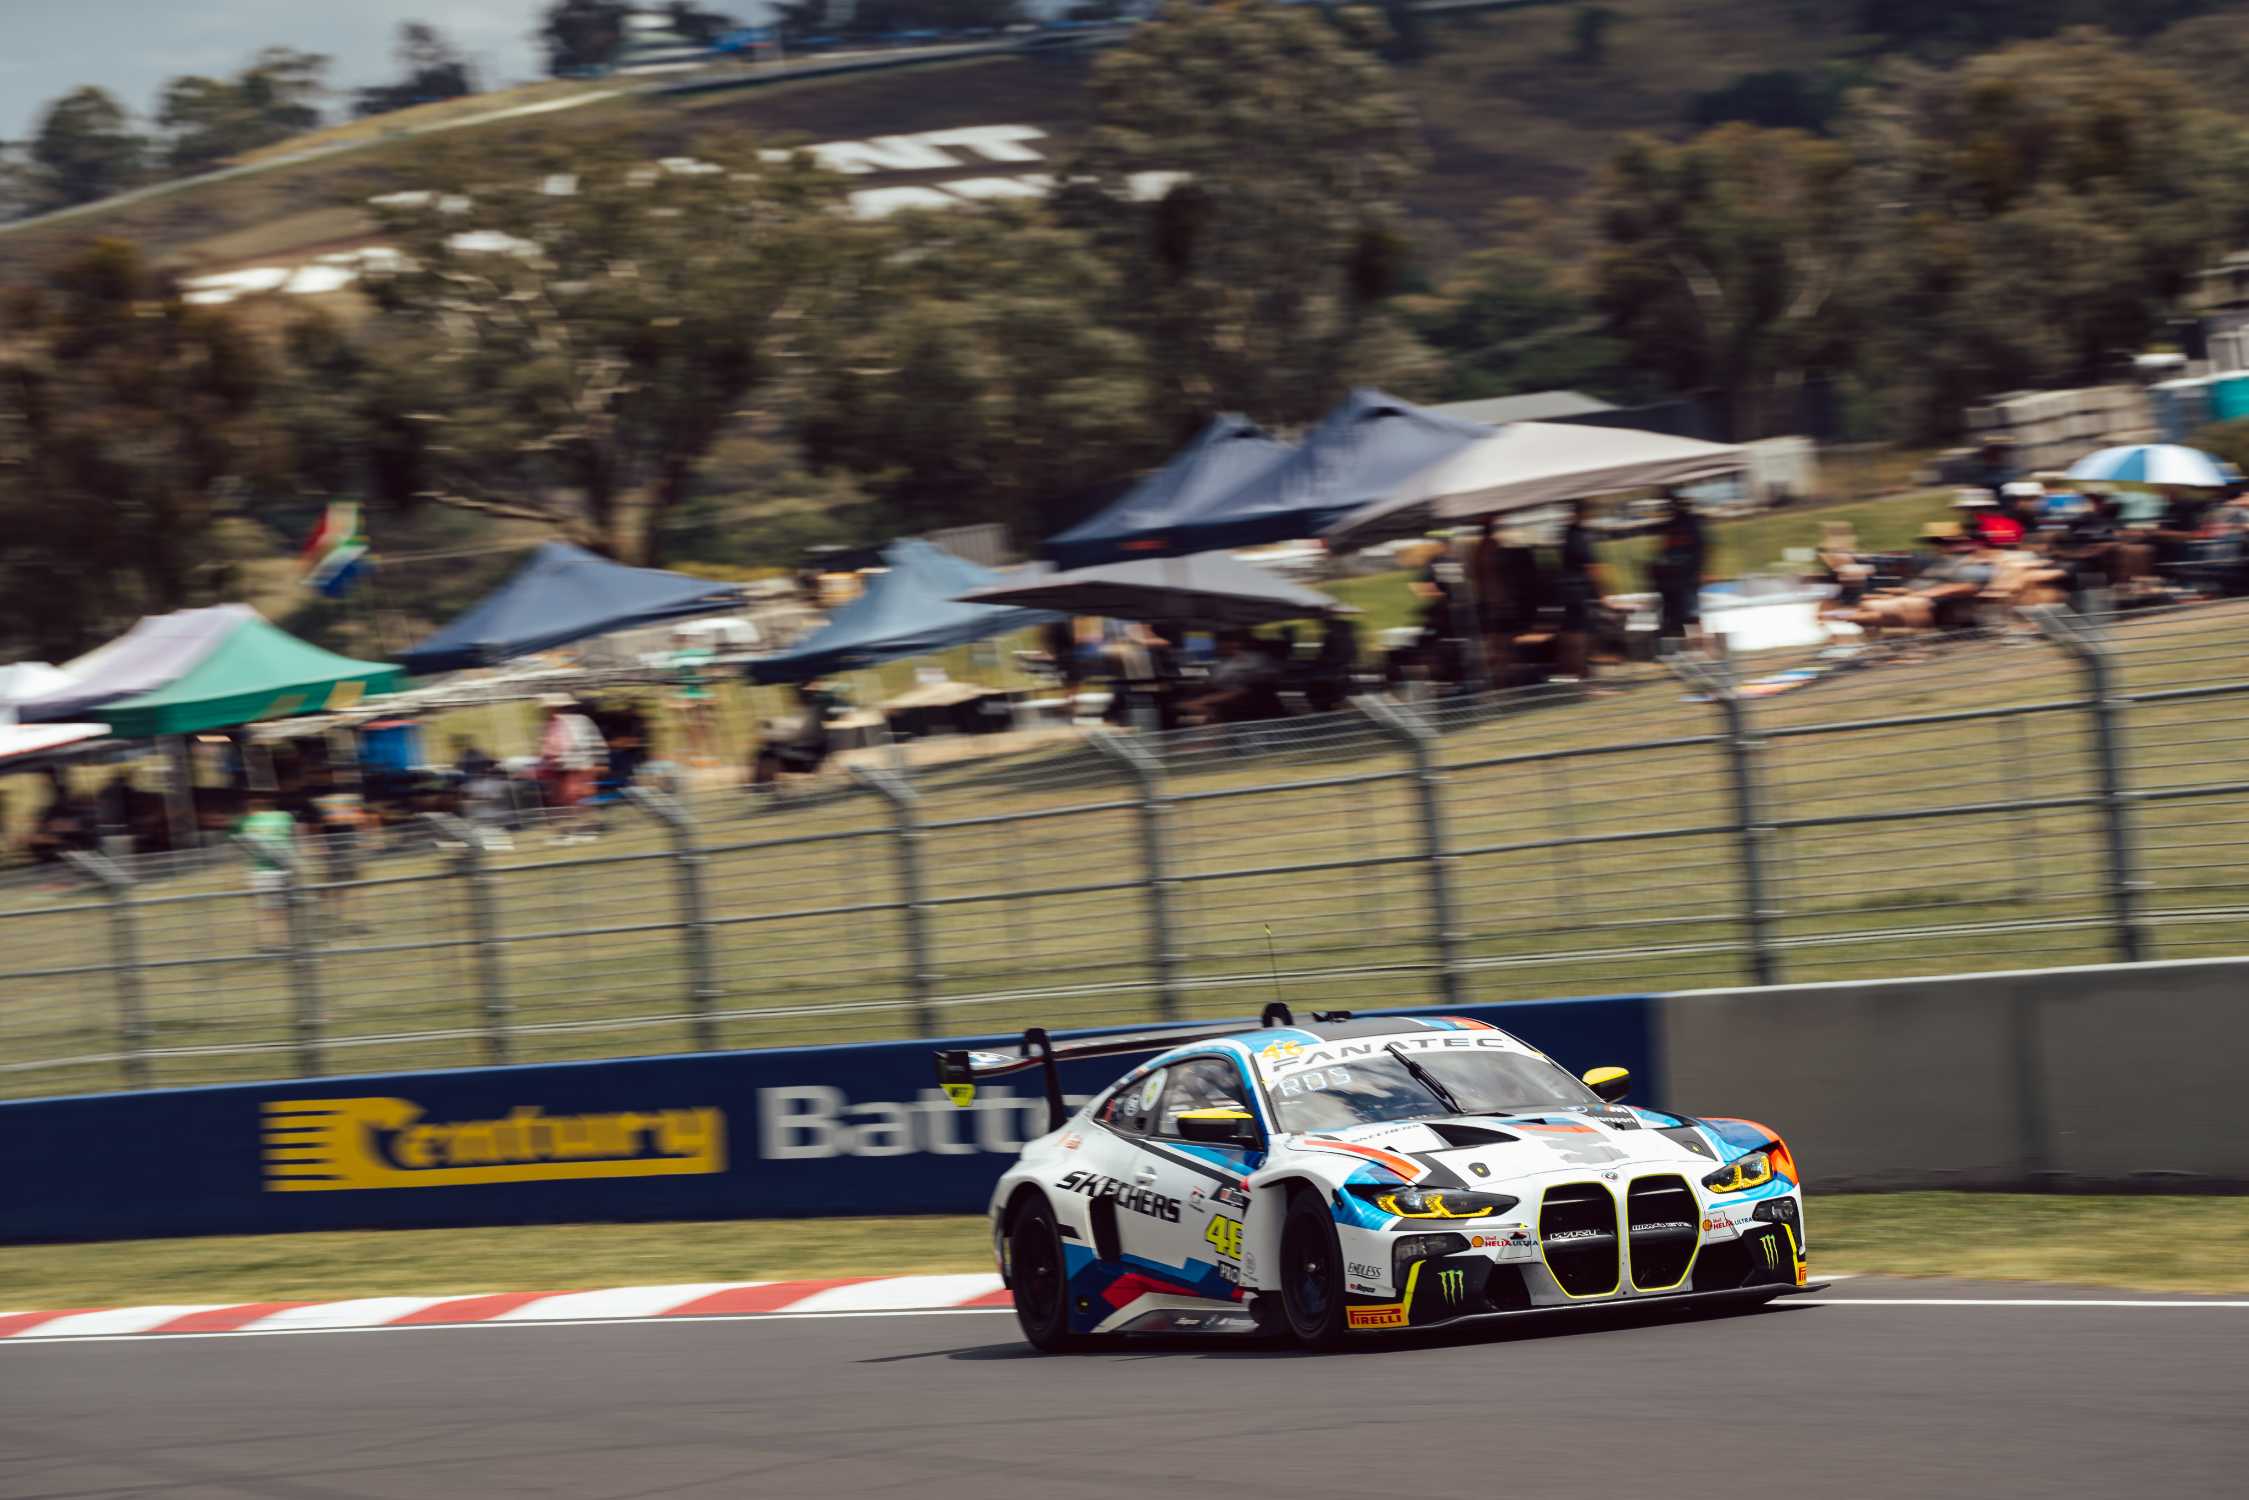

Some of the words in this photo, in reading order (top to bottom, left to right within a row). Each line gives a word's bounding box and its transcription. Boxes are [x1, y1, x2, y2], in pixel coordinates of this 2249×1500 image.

[1273, 1037, 1507, 1073] FANATEC
[1279, 1066, 1353, 1097] ROS
[1055, 1171, 1182, 1223] SKECHERS
[1347, 1262, 1383, 1279] ENDLESS
[1349, 1308, 1403, 1325] PIRELLI
